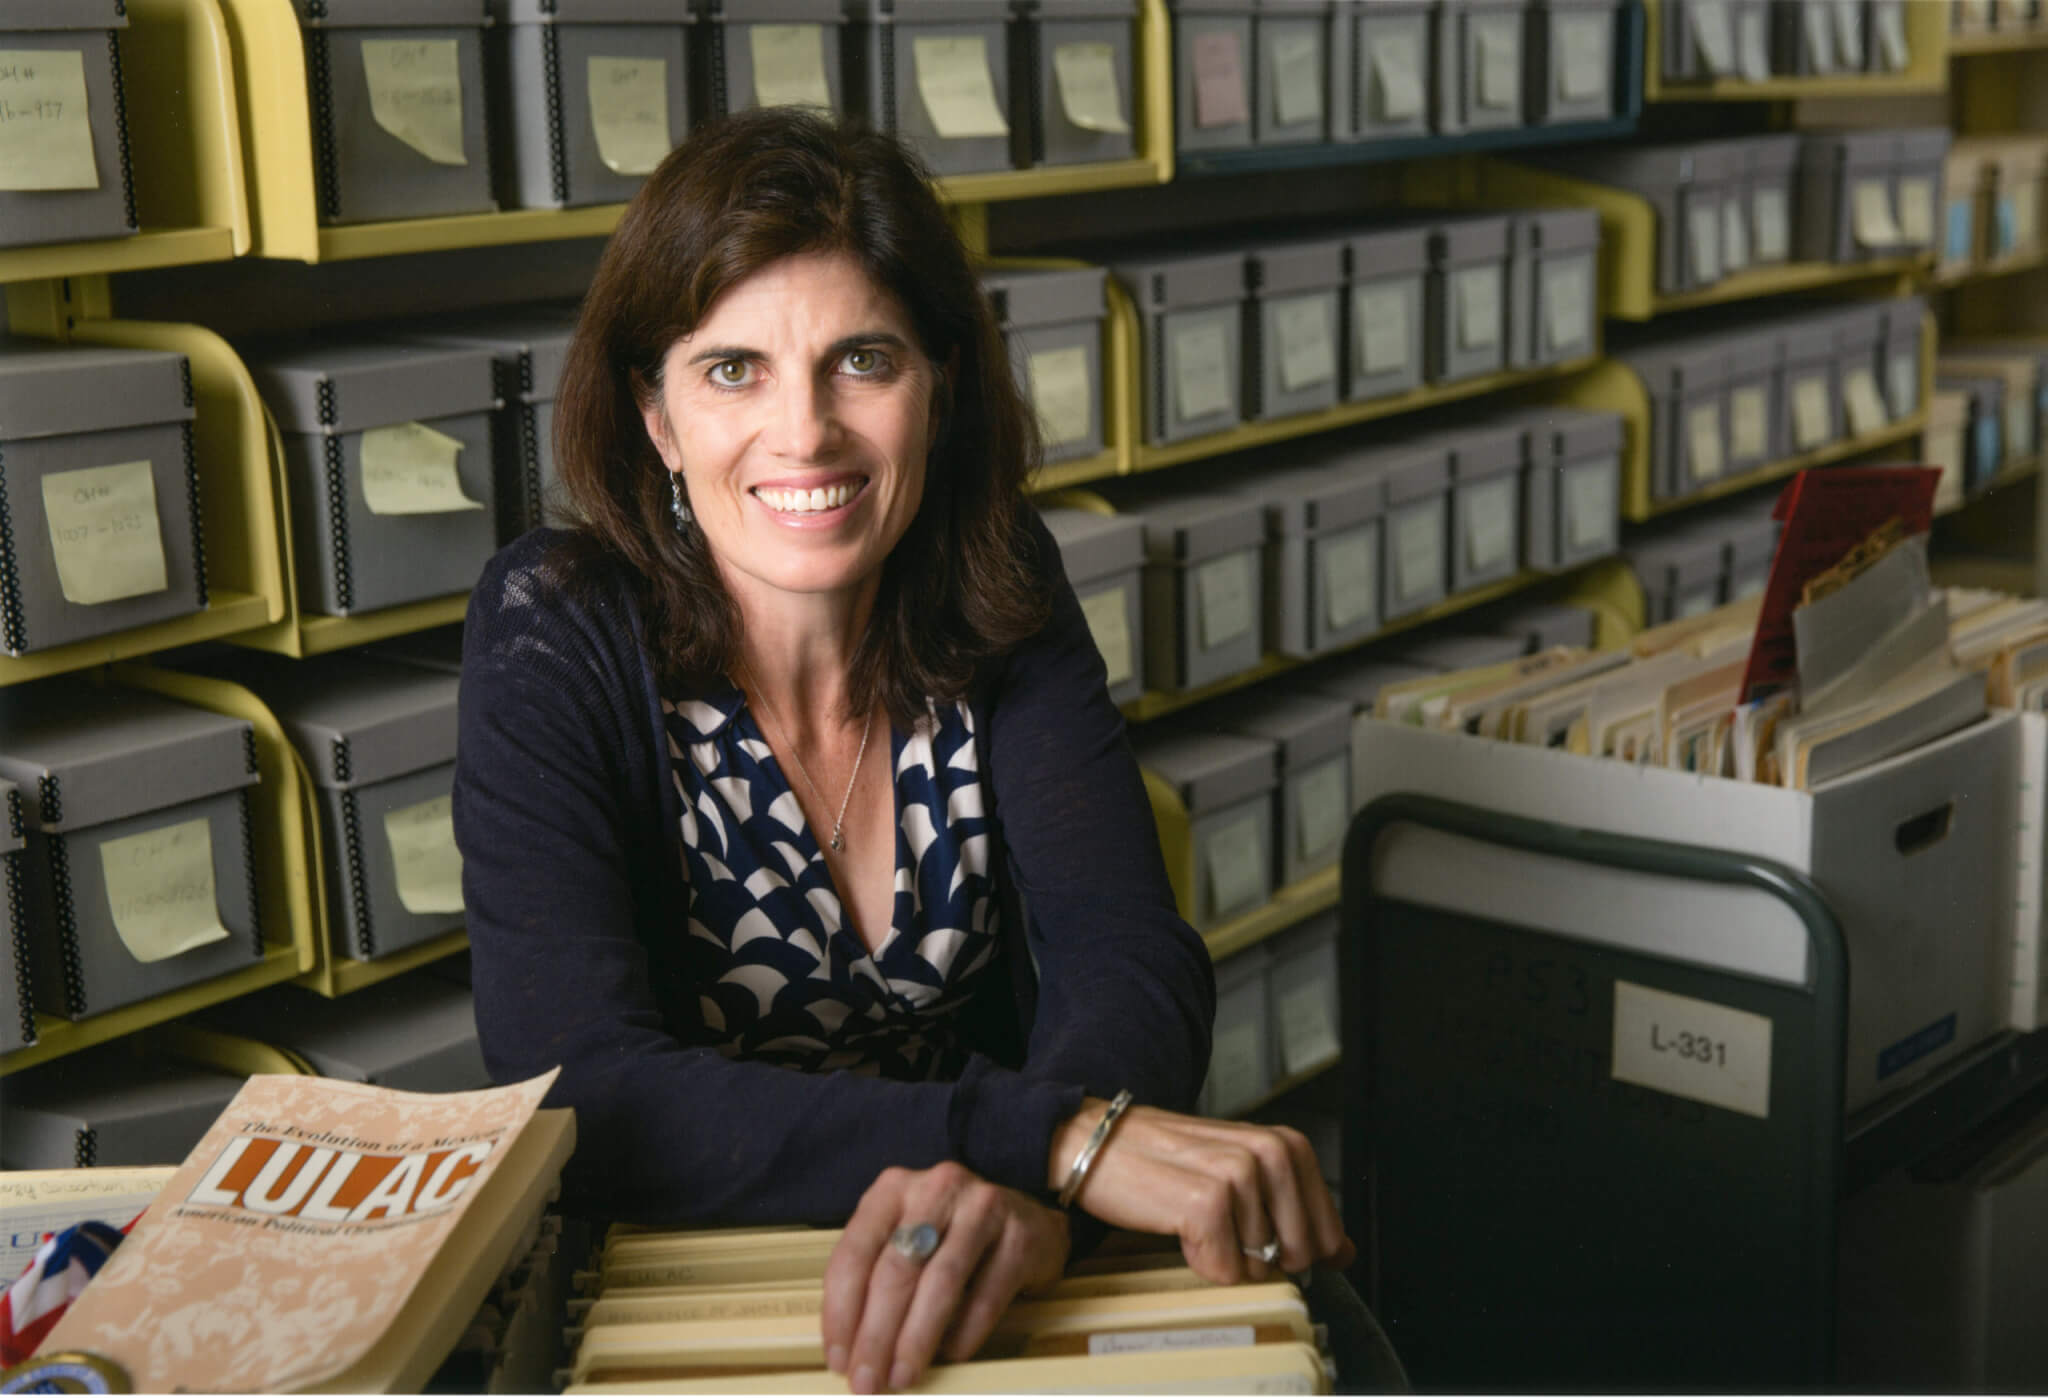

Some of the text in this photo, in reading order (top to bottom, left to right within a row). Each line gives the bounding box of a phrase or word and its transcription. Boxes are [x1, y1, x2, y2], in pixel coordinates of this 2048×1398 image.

[1651, 1023, 1726, 1067] L-331
[242, 1121, 277, 1135] The
[283, 1126, 381, 1150] Evolution
[385, 1142, 408, 1152] of
[185, 1136, 493, 1222] LULAC
[176, 1207, 258, 1226] American
